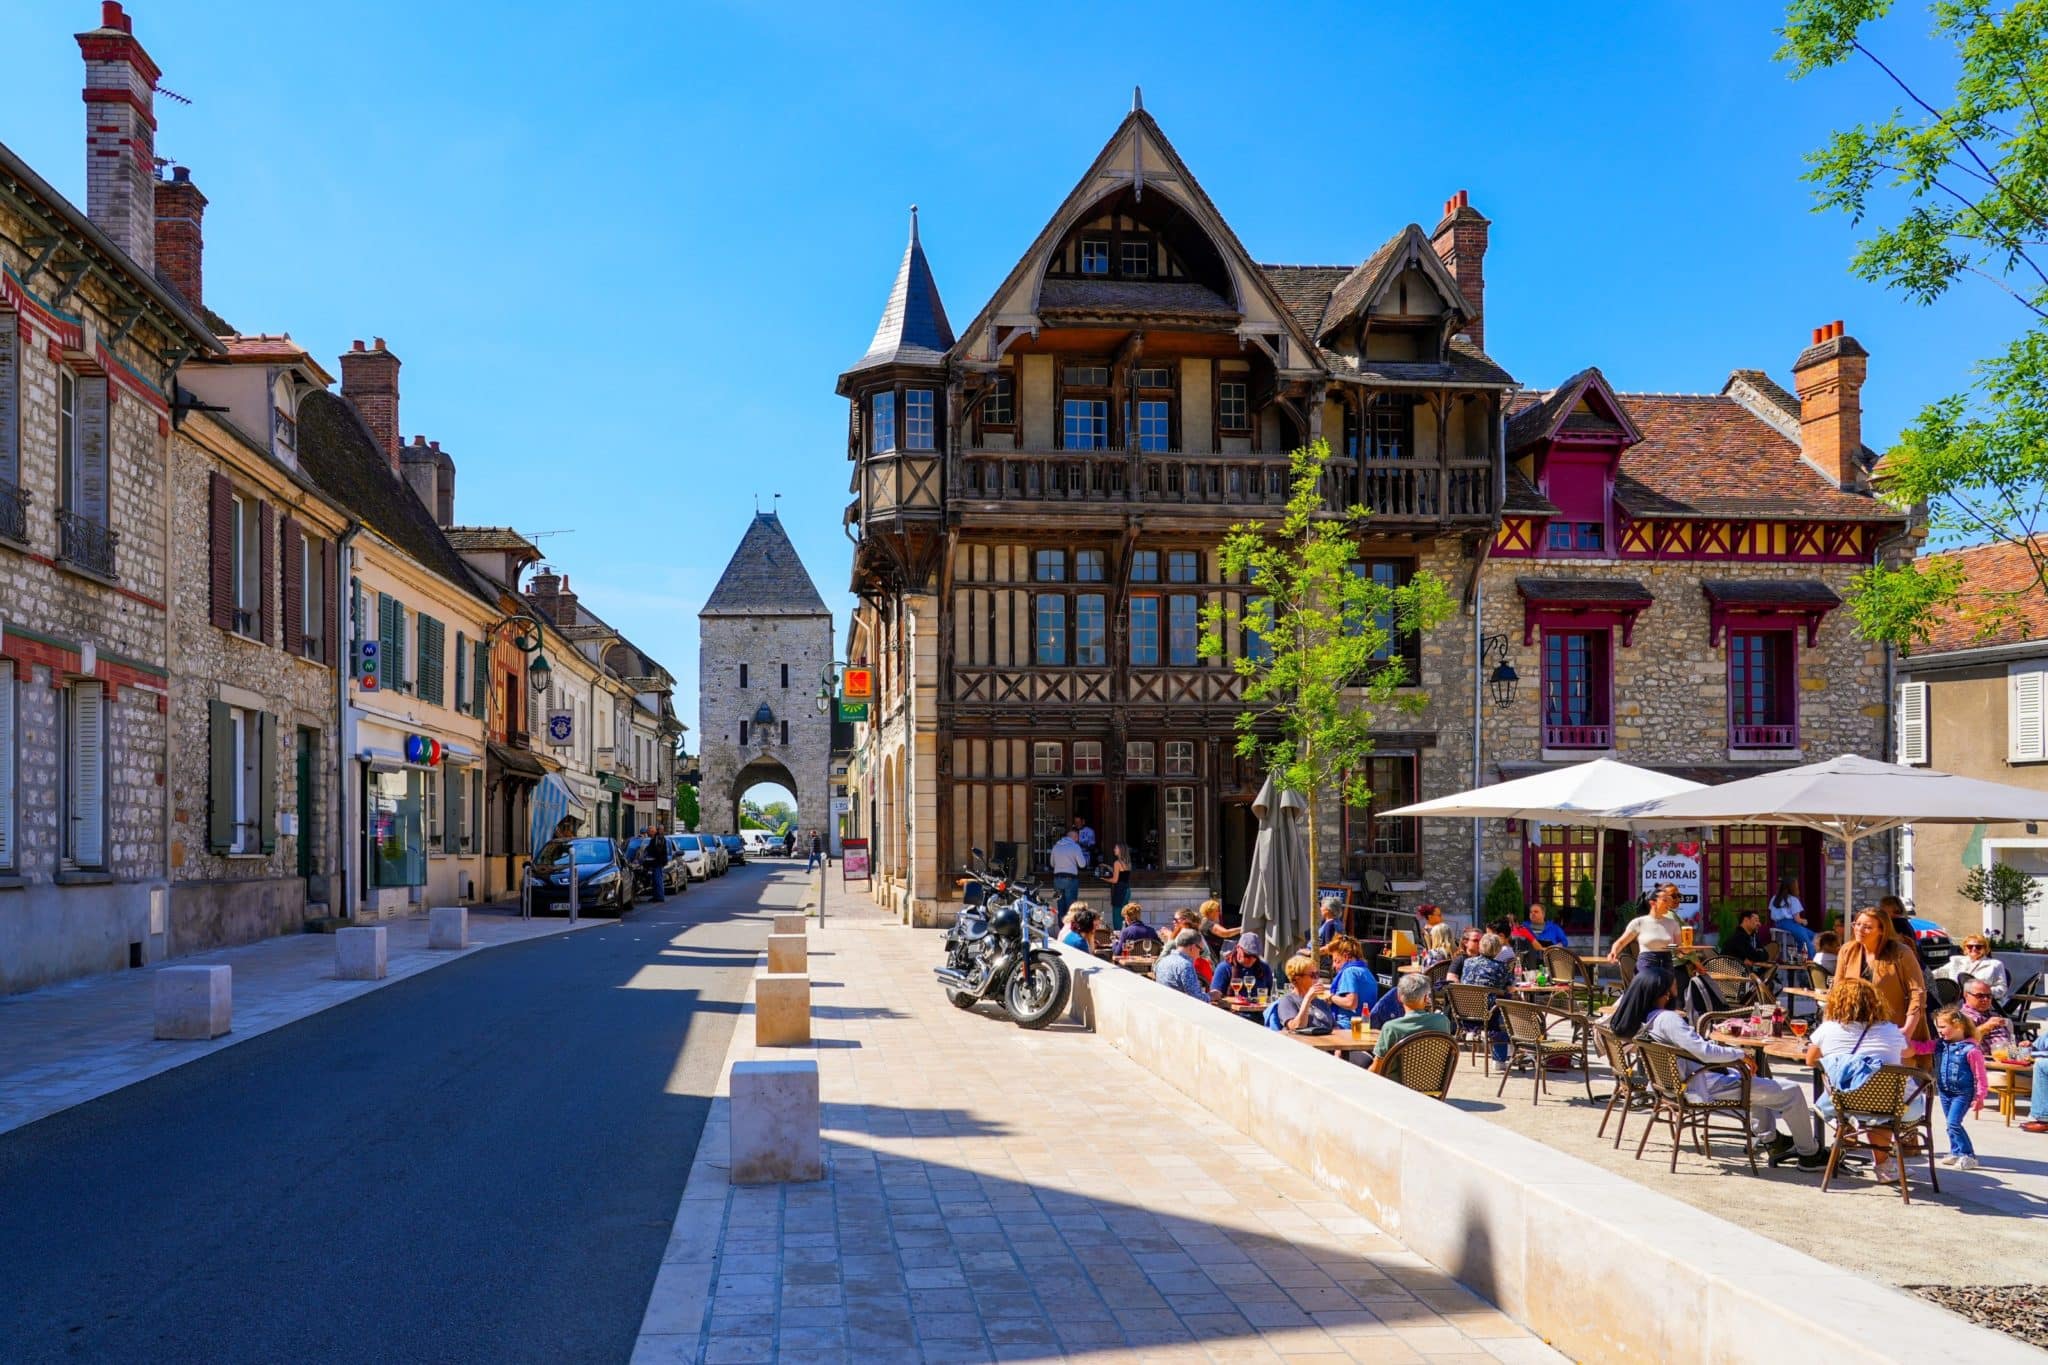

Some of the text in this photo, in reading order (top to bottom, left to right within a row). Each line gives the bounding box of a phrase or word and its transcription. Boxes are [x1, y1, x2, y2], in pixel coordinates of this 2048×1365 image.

[1657, 860, 1685, 868] Coiffure
[1645, 870, 1697, 879] DE MORAIS
